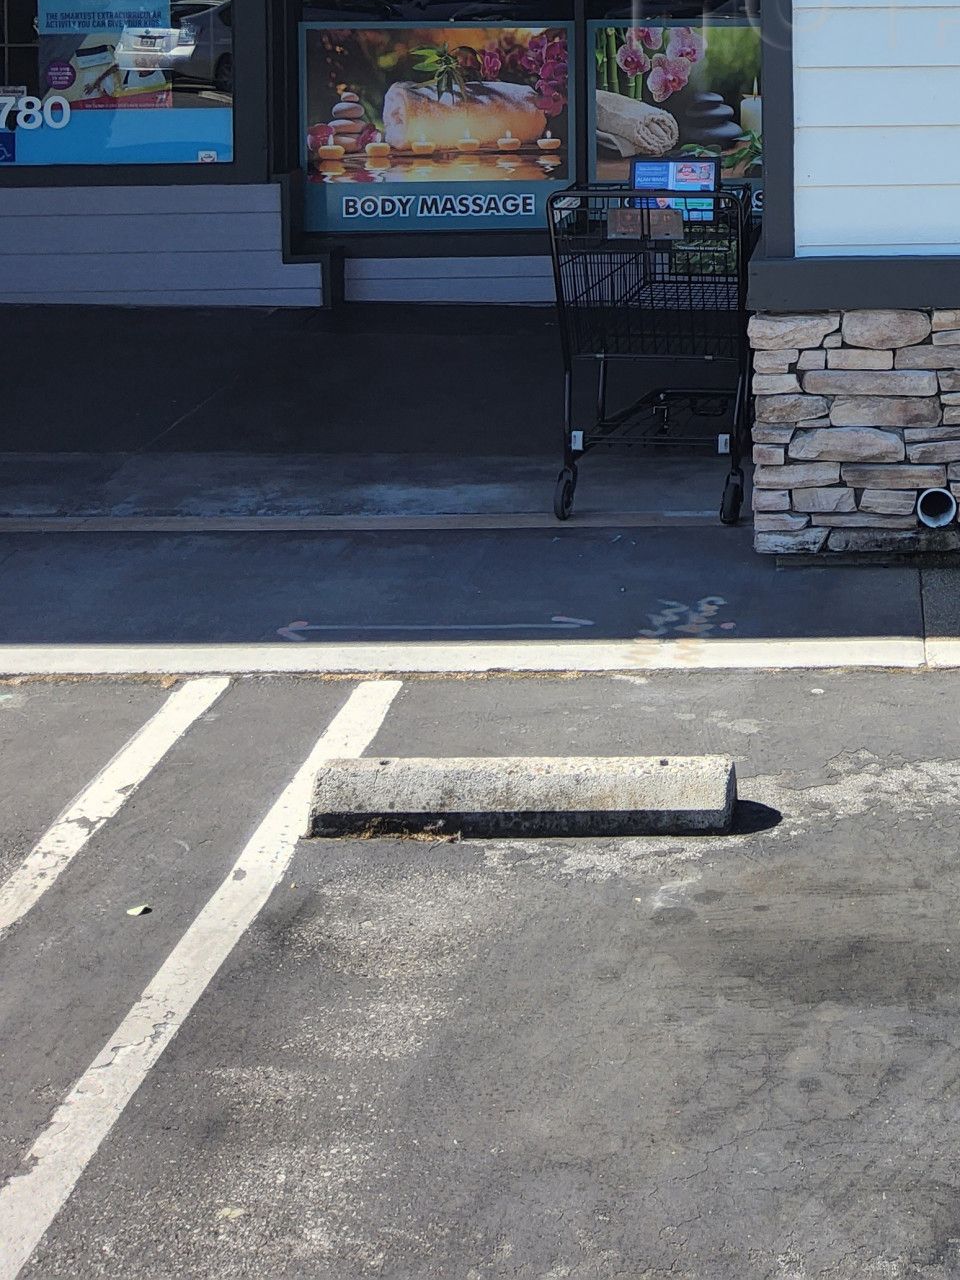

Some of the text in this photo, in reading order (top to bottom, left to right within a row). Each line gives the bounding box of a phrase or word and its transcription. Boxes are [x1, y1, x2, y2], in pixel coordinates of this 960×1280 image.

[46, 11, 58, 20] THE
[59, 11, 96, 20] SMARTEST
[45, 20, 76, 29] ACTIVITY
[77, 20, 91, 29] YOU
[92, 20, 106, 29] CAN
[107, 20, 123, 29] GIVE
[342, 193, 536, 218] BODY MASSAGE
